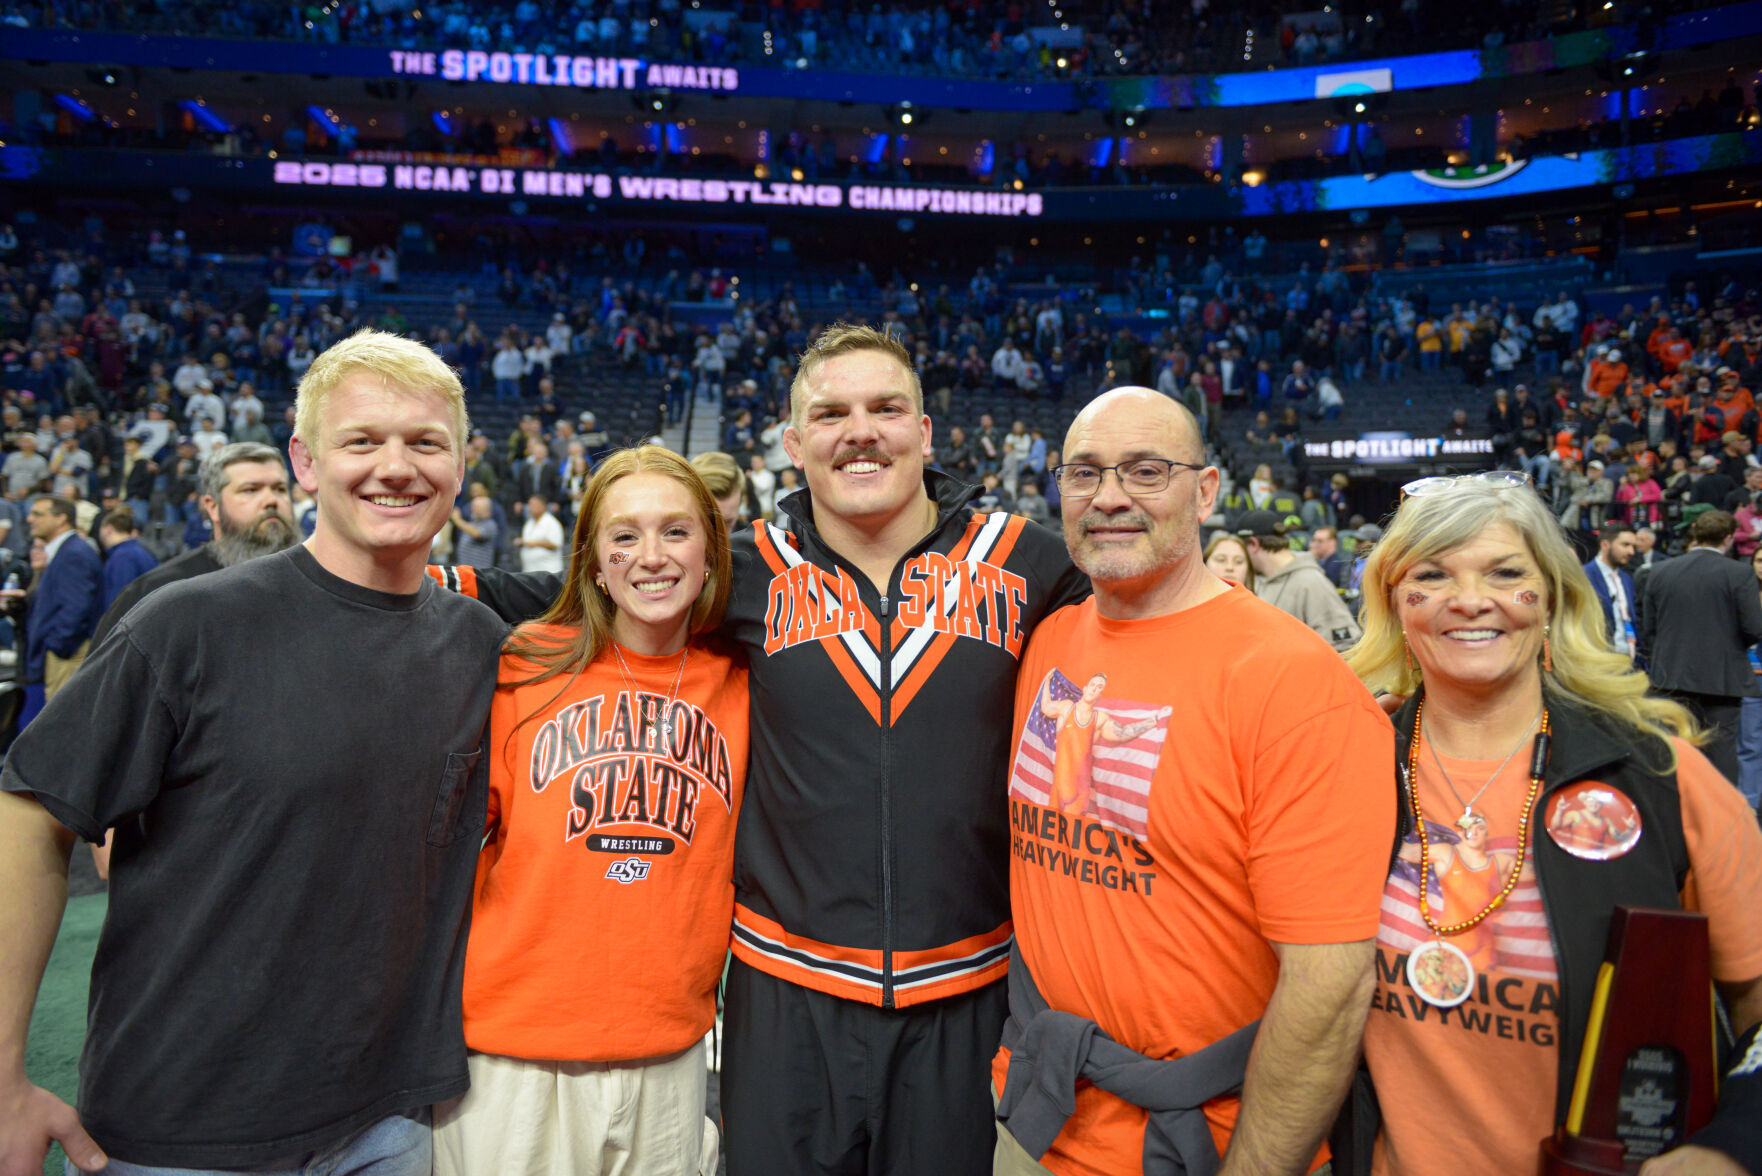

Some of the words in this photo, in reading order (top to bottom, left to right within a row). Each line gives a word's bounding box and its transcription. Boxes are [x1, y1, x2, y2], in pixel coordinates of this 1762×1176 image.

[390, 50, 436, 74] THE
[442, 49, 639, 89] SPOTLIGHT
[647, 64, 738, 90] AWAITS
[274, 161, 387, 188] 2025
[480, 168, 516, 194] DI
[522, 170, 612, 198] MEN'S
[618, 176, 842, 207] WRESTLING
[849, 185, 1043, 216] CHAMPIONSHIPS
[1304, 442, 1329, 457] THE
[1331, 438, 1442, 458] SPOTLIGHT
[1441, 439, 1494, 453] AWAITS
[764, 560, 865, 657] OKLA
[897, 551, 1028, 662] STATE
[530, 690, 733, 816] OKLAHOMA
[565, 755, 701, 847] STATE
[601, 837, 663, 852] WRESTLING
[1012, 801, 1155, 866] AMERICA'S
[604, 856, 652, 884] OSU
[1013, 835, 1156, 896] HEAVYWEIGHT
